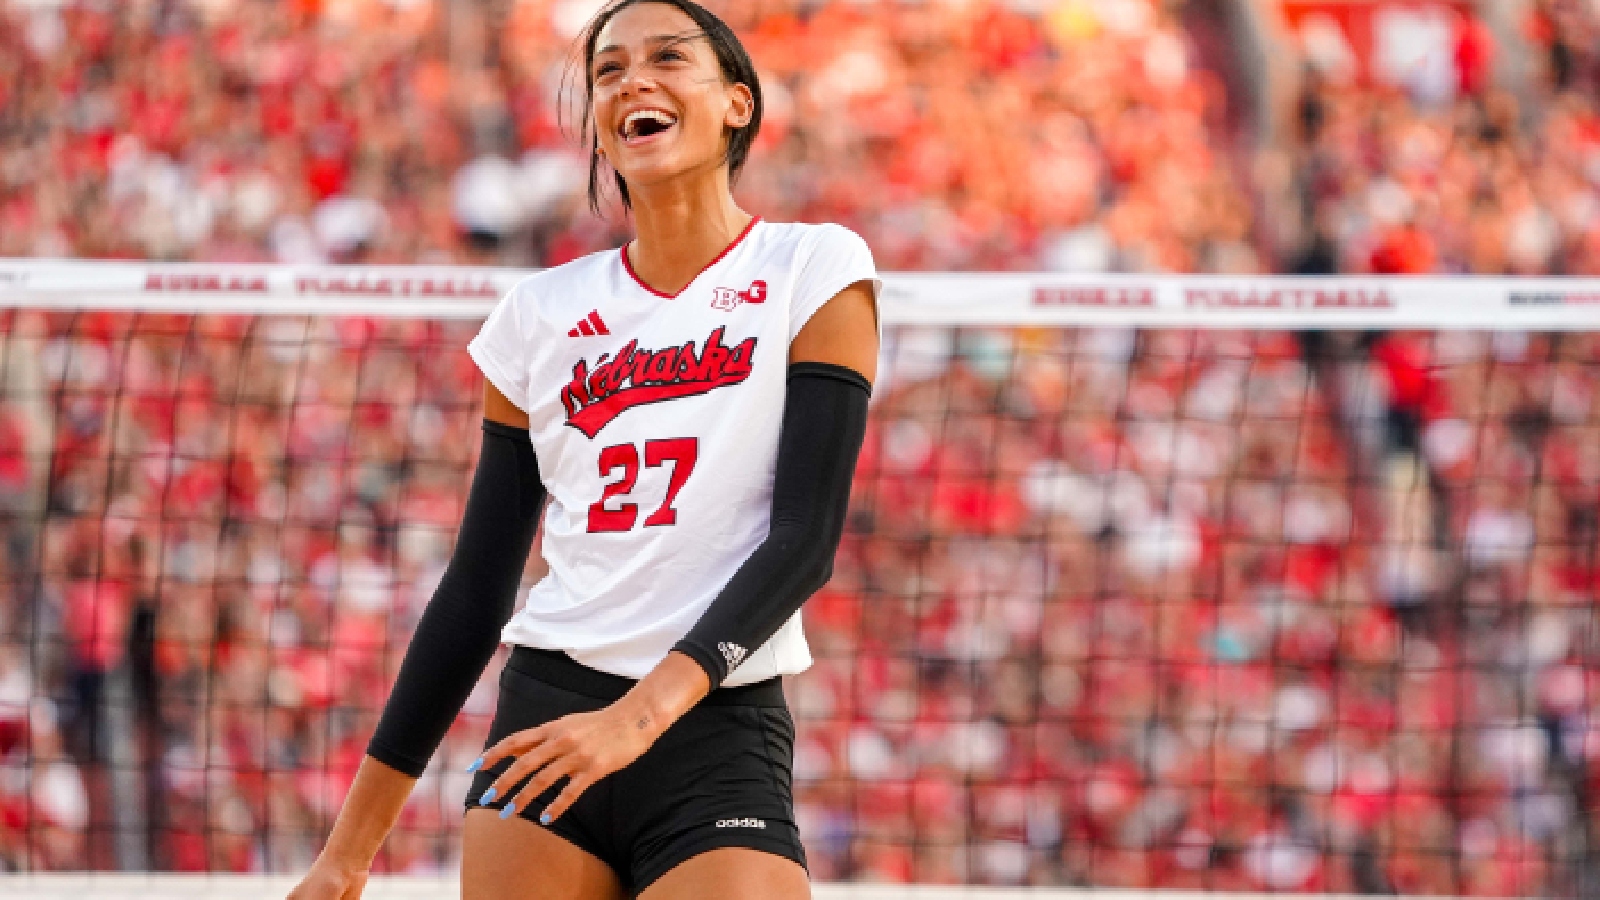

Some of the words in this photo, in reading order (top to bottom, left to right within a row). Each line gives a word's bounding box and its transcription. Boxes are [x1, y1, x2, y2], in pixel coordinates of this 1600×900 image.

[560, 325, 758, 420] Nebraska
[586, 436, 699, 533] 27
[715, 817, 767, 830] adidas
